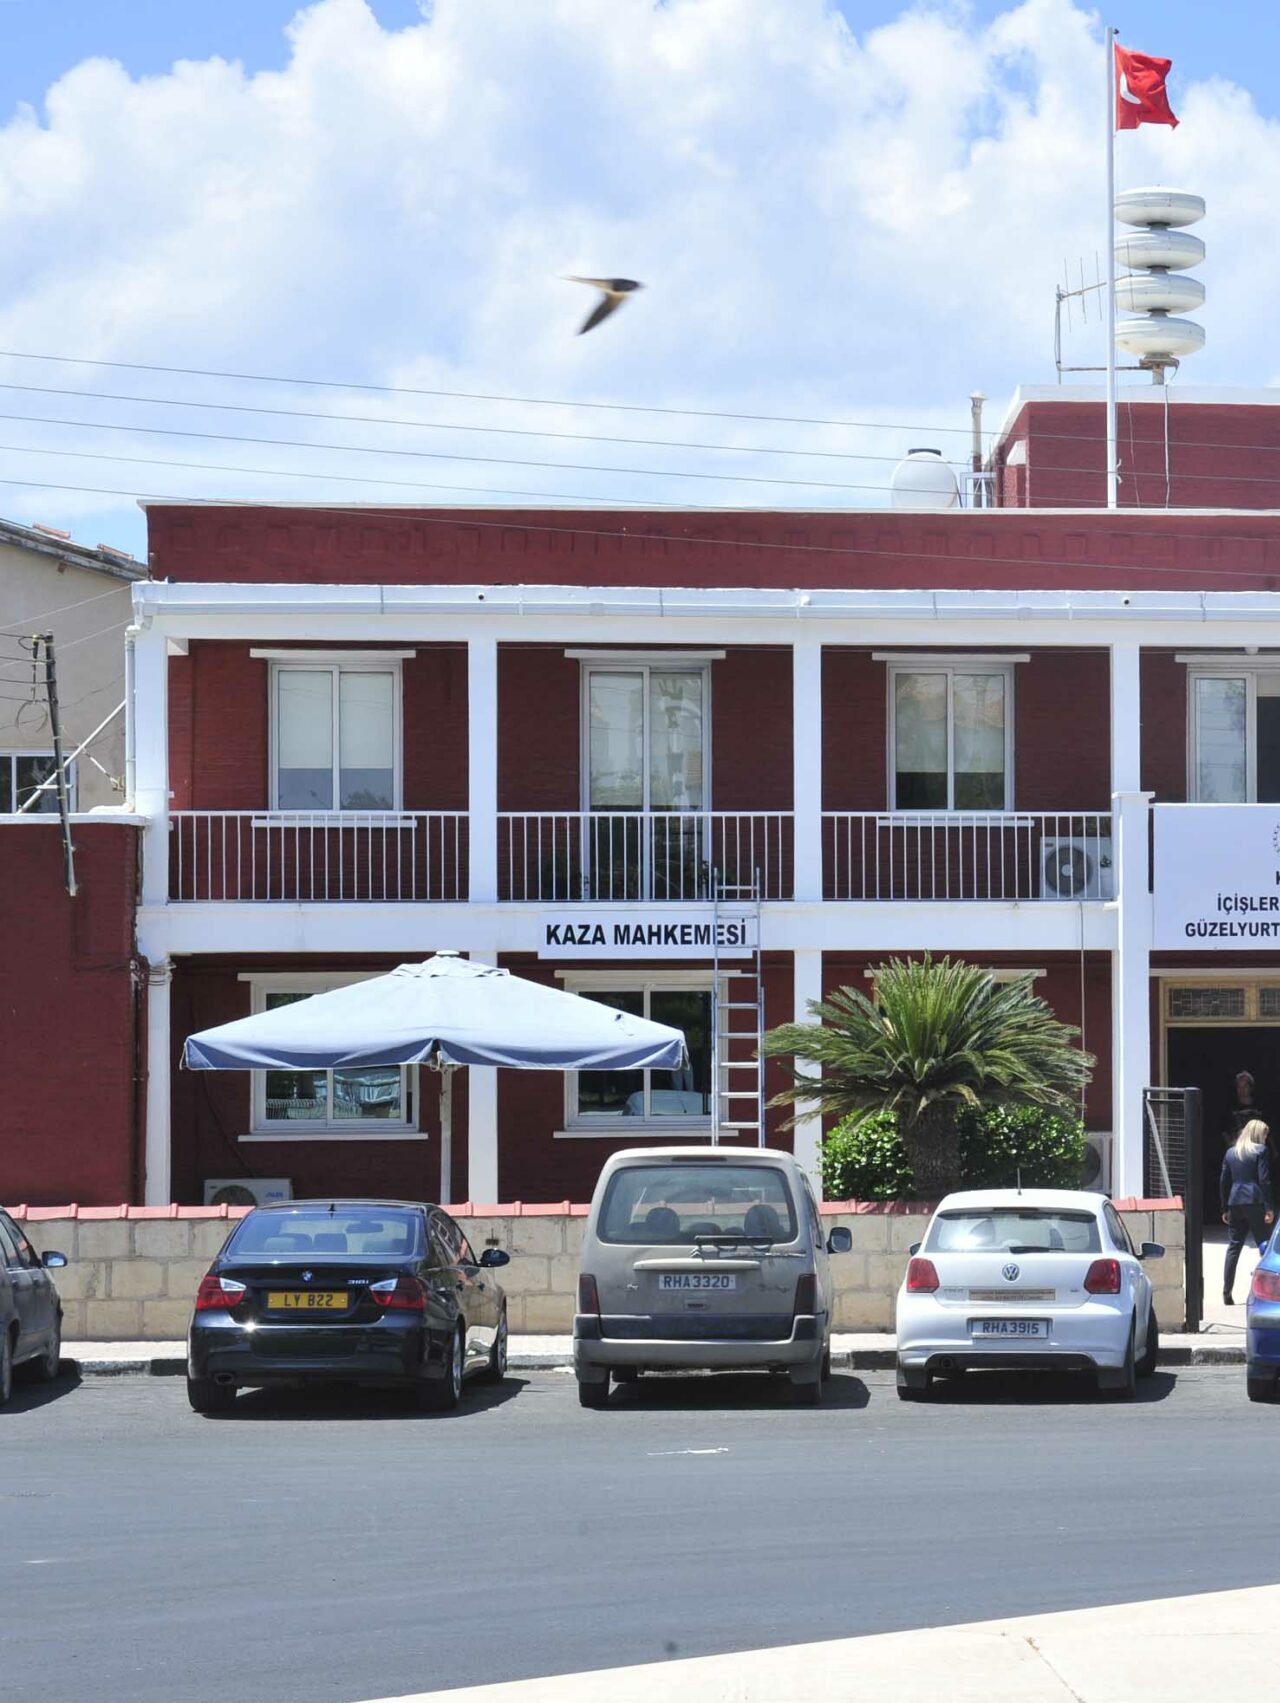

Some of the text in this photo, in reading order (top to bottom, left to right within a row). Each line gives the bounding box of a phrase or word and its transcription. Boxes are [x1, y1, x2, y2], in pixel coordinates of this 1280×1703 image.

[546, 918, 746, 945] KAZA MAHKEMESİ
[1185, 919, 1280, 937] GÜZELYURT
[663, 1275, 730, 1288] RHA3320
[284, 1294, 301, 1307] LY
[982, 1322, 1039, 1334] RHA3915
